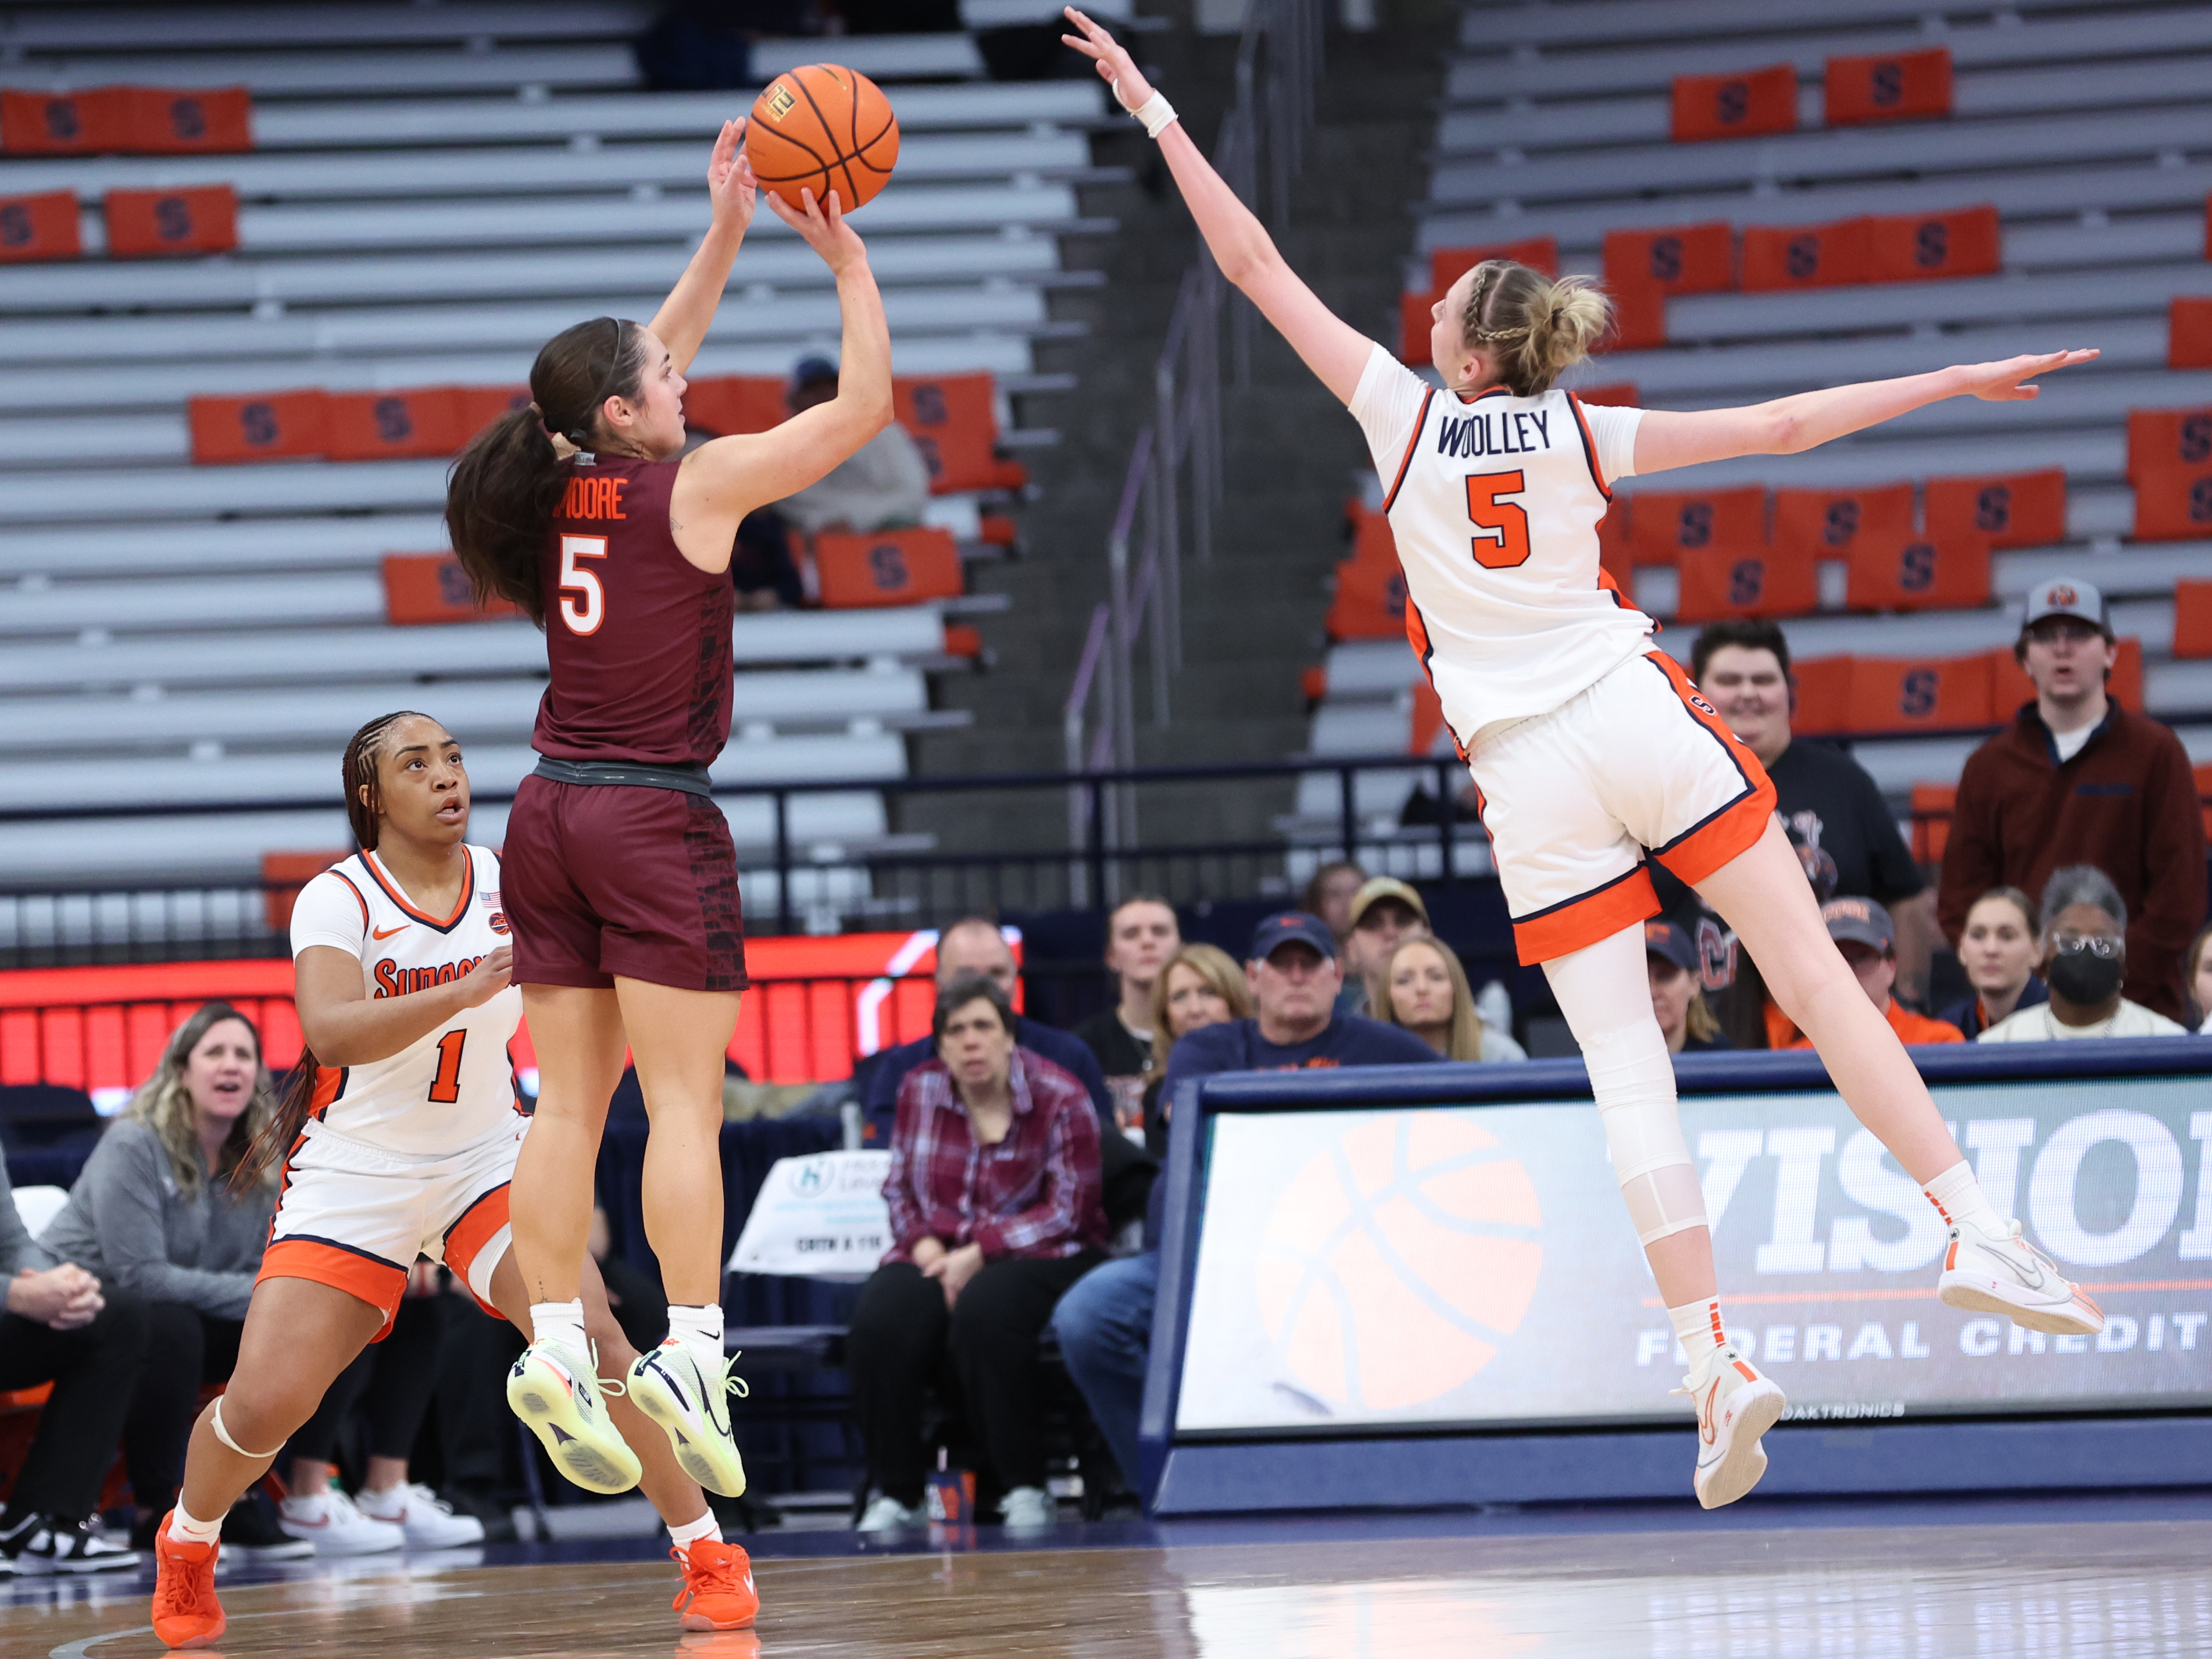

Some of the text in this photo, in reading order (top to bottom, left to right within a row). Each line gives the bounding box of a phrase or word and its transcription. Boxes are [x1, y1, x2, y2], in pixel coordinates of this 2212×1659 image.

[1438, 409, 1550, 458] WOOLLEY
[1465, 469, 1531, 569] 5
[1678, 502, 1713, 548] S
[1975, 485, 2011, 532] S
[559, 533, 608, 636] 5
[1728, 559, 1764, 606] S
[1899, 544, 1936, 591] S
[1689, 695, 1717, 717] S
[1900, 669, 1938, 717] S
[428, 1029, 467, 1103] 1
